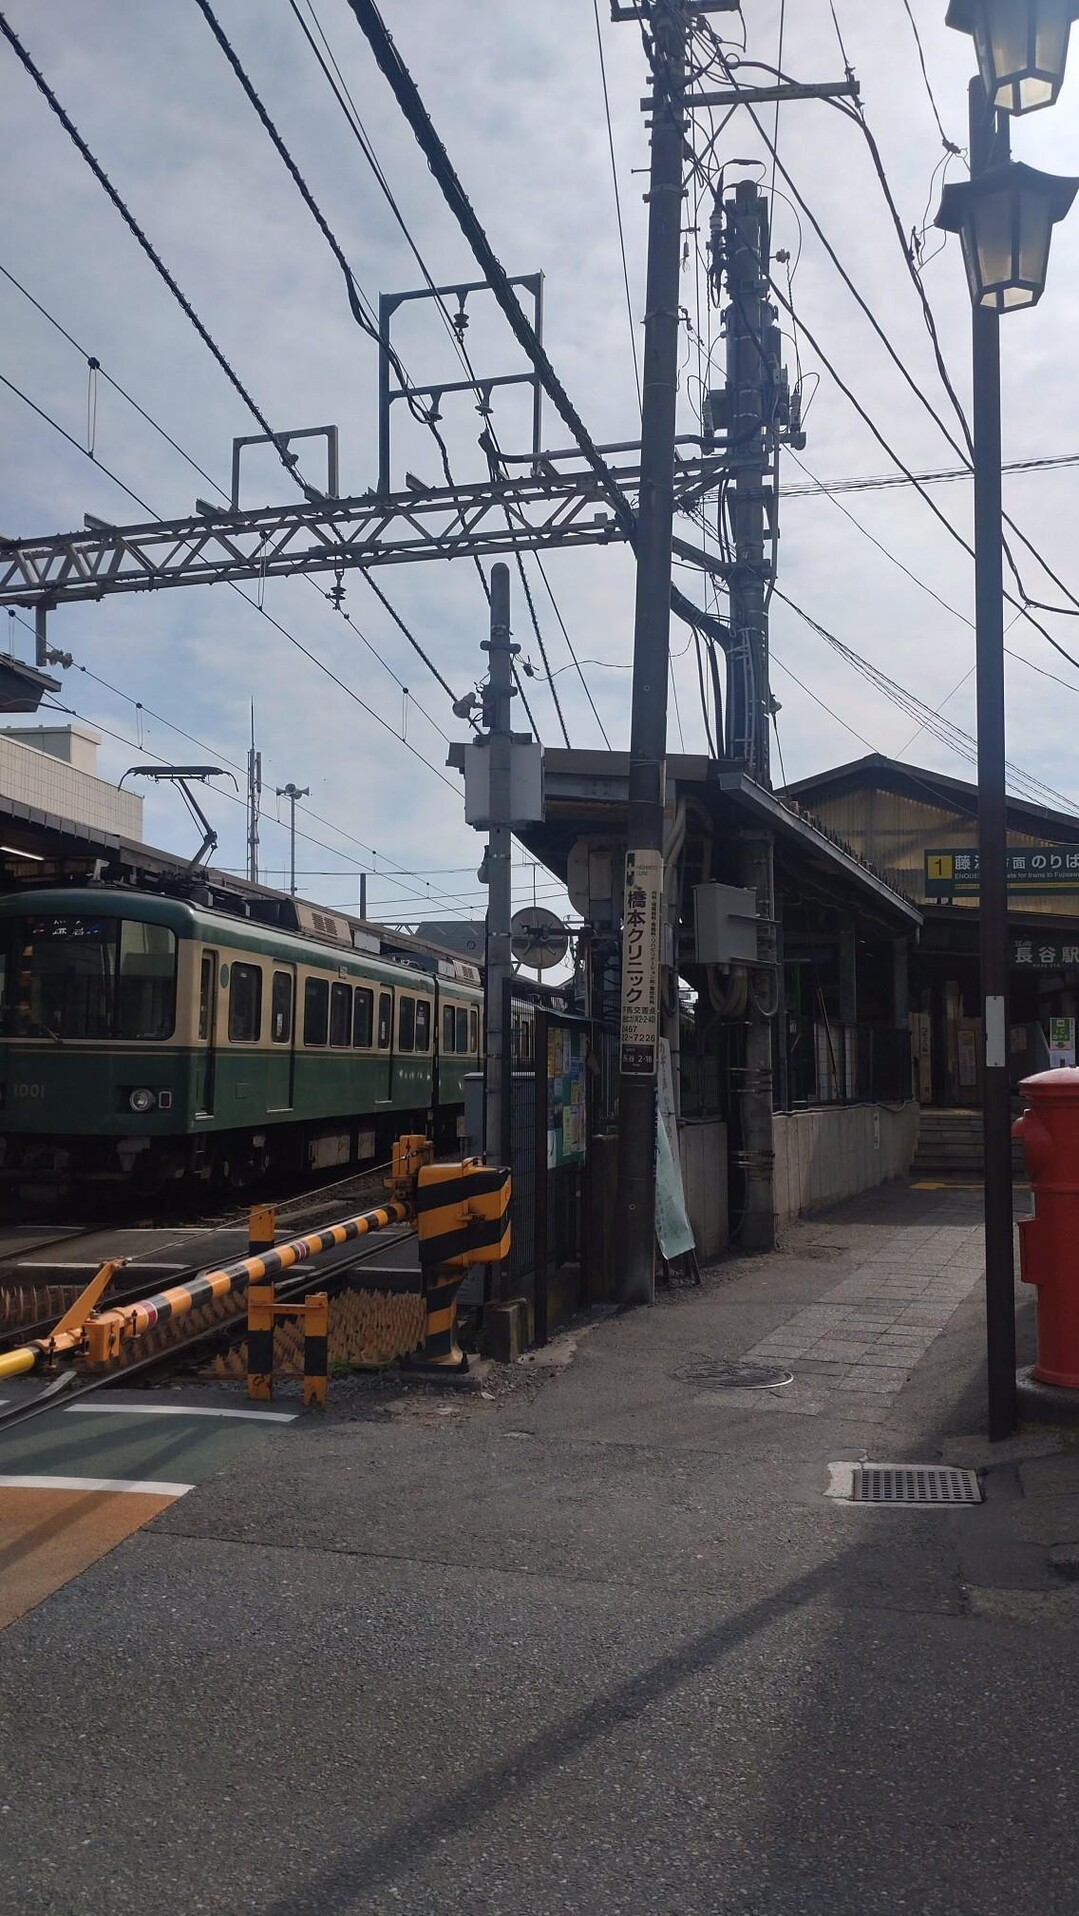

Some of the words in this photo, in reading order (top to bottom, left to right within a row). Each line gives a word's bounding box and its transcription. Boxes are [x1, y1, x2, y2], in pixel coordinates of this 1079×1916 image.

[935, 859, 942, 876] 1
[955, 872, 980, 880] ENODE
[626, 889, 647, 1003] 橋本クリニック
[1014, 947, 1079, 964] 長谷駅
[14, 1083, 45, 1098] 1001
